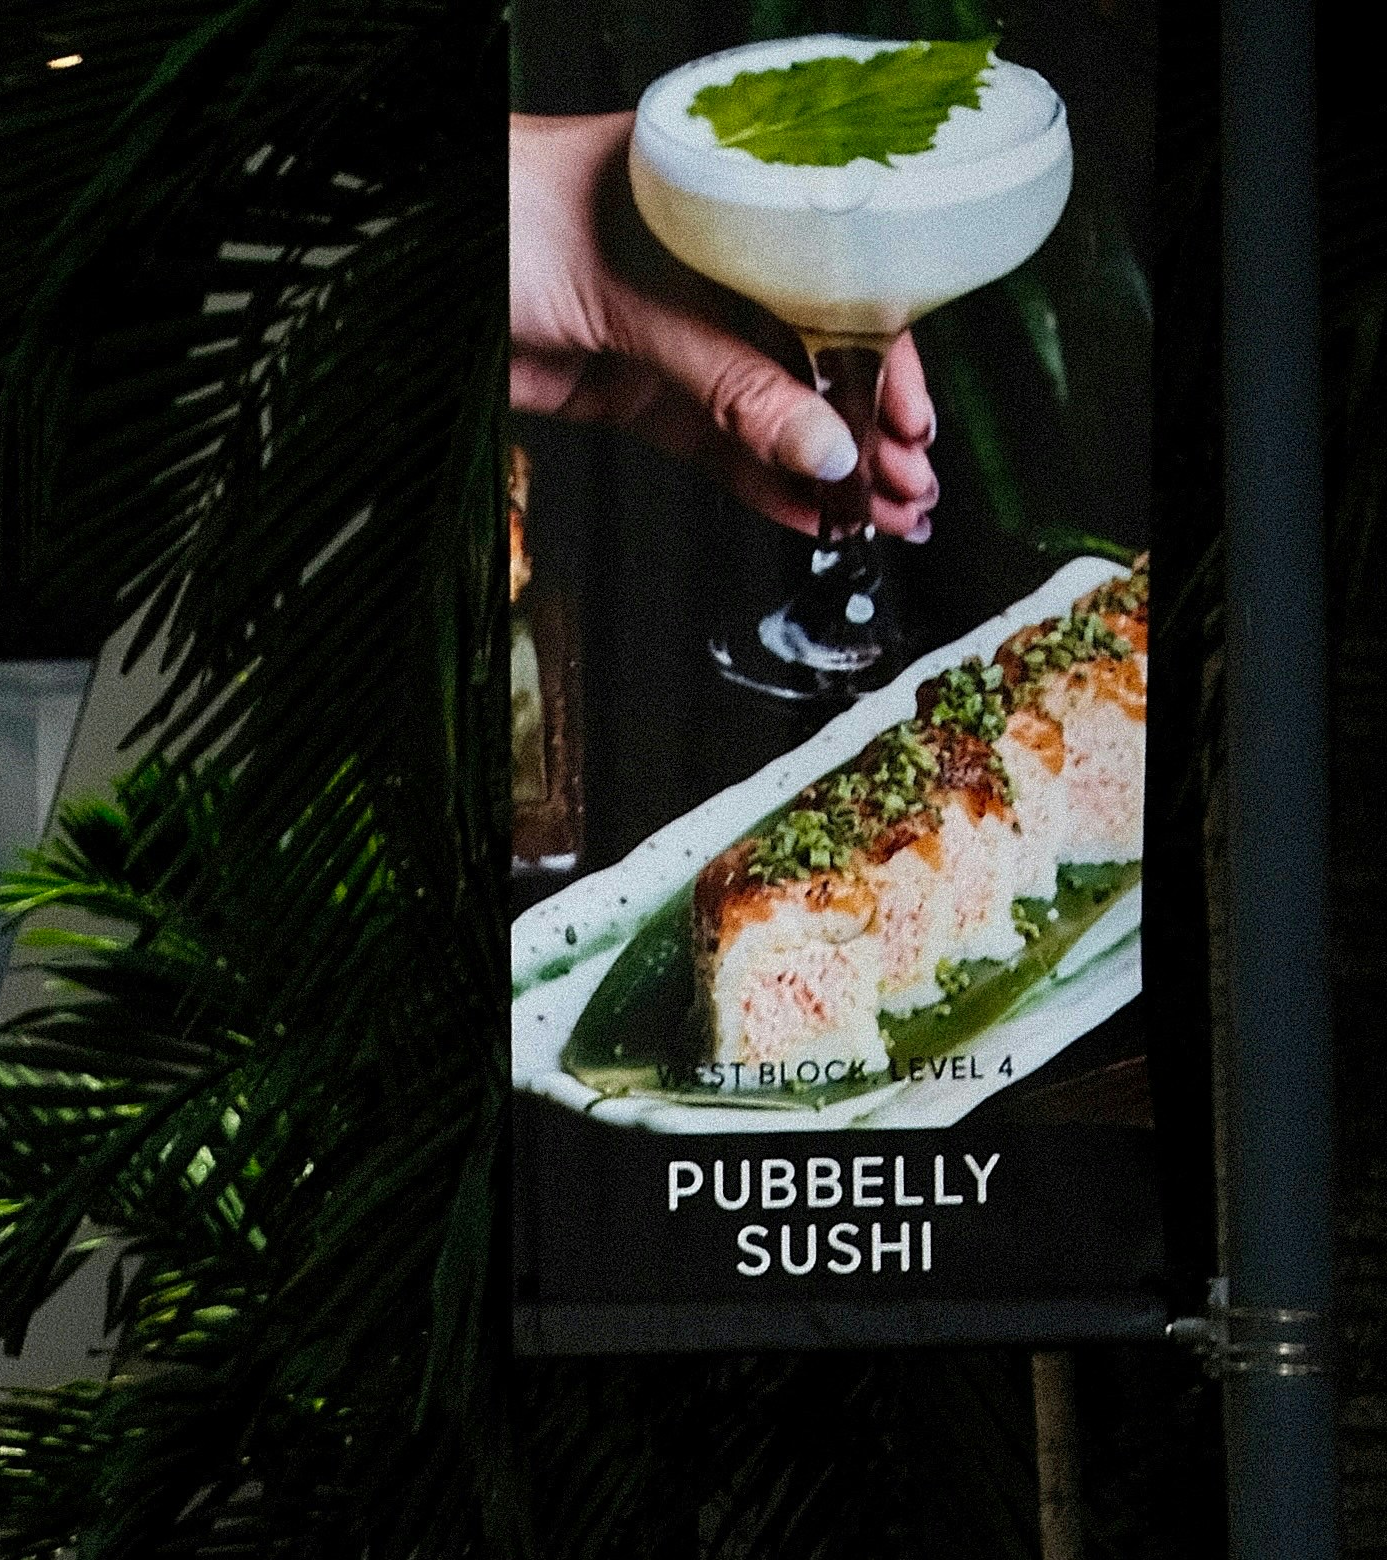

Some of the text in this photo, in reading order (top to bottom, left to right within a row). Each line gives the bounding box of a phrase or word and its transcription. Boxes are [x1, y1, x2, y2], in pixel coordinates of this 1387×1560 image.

[888, 1055, 983, 1082] LEVEL
[997, 1054, 1014, 1079] 4
[668, 1152, 1001, 1211] PUBBELLY
[736, 1220, 933, 1277] SUSHI
